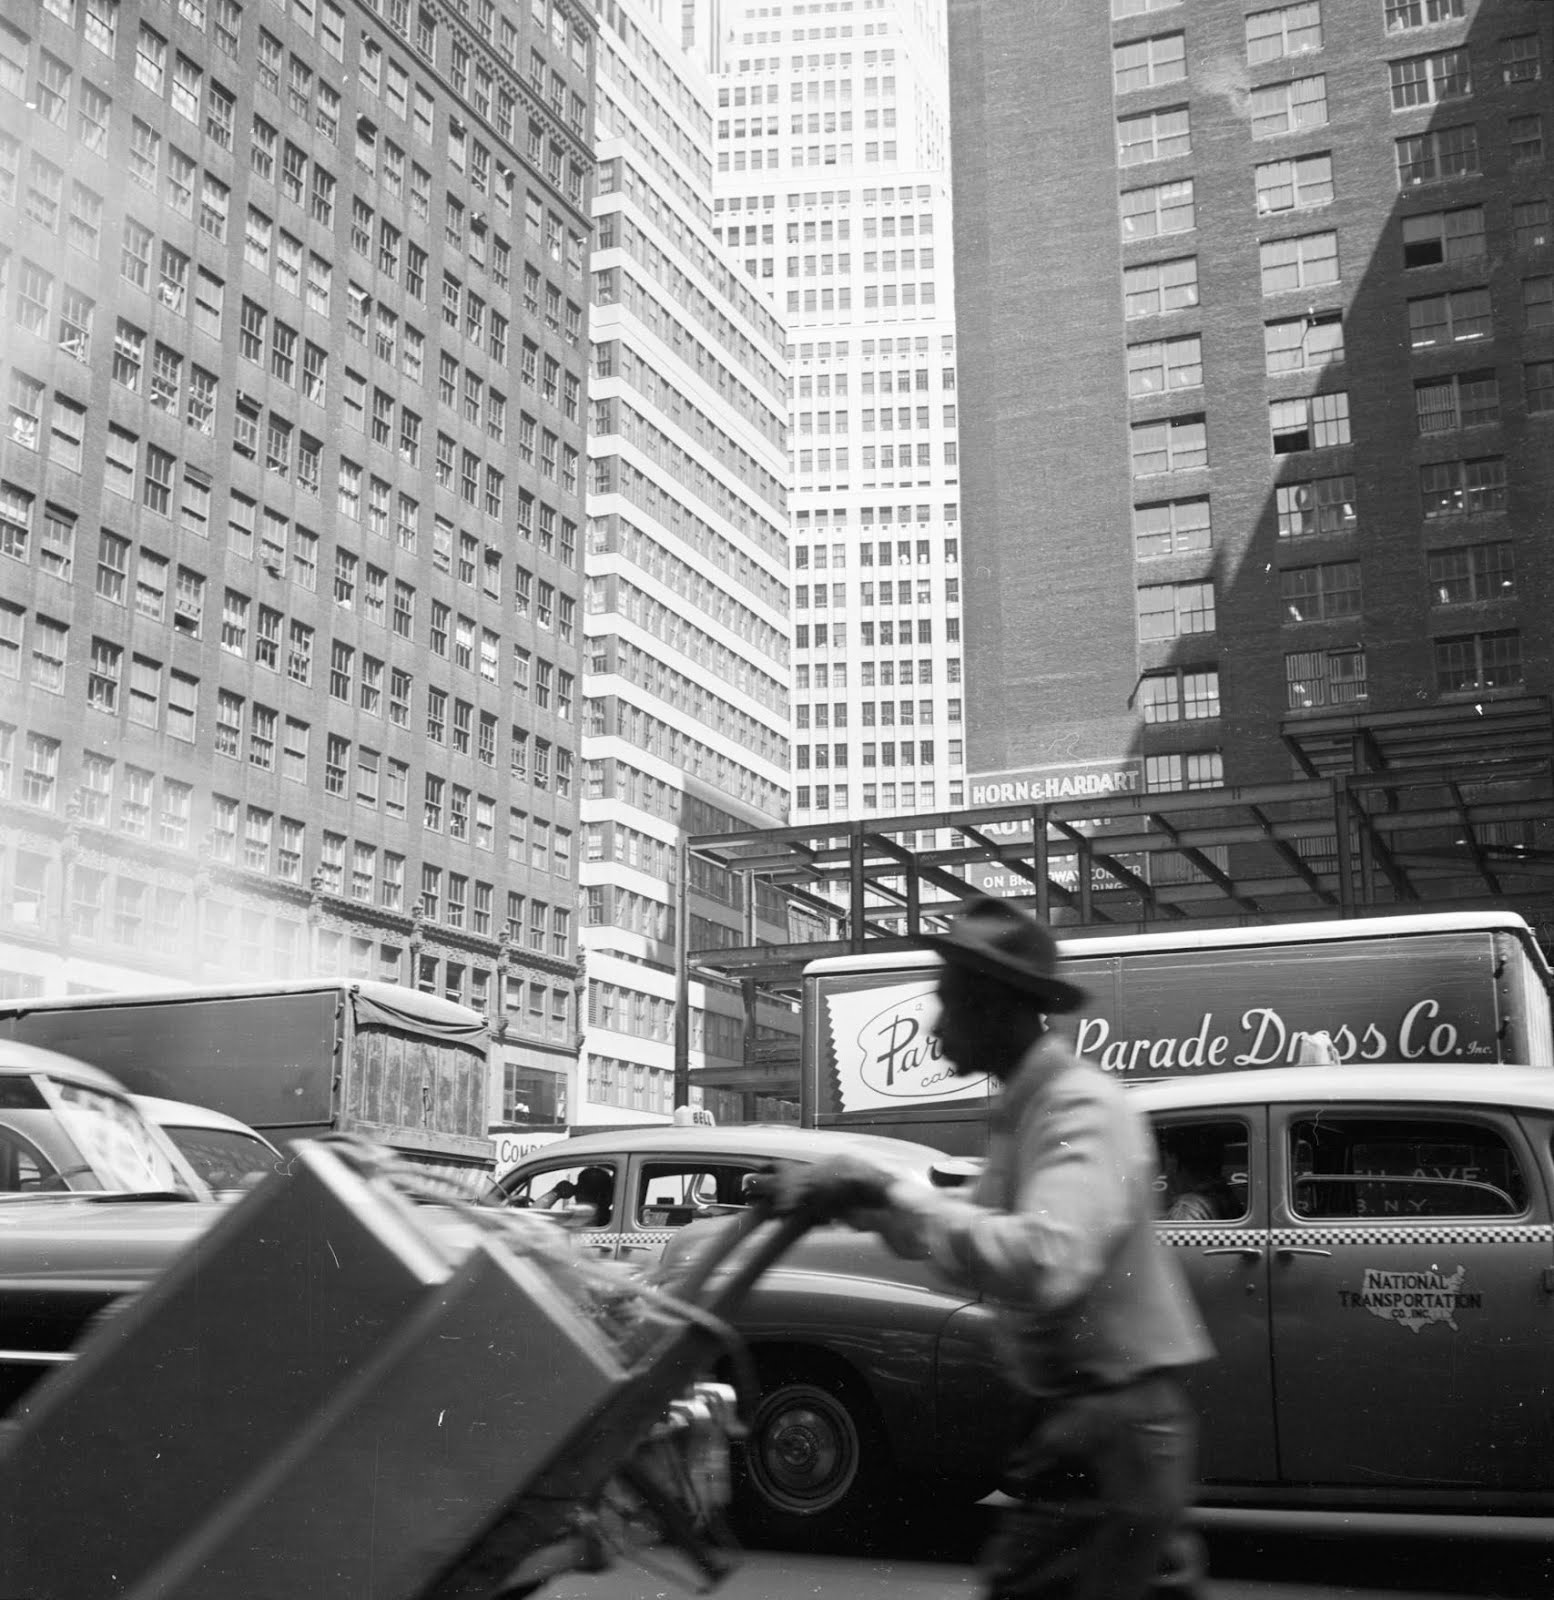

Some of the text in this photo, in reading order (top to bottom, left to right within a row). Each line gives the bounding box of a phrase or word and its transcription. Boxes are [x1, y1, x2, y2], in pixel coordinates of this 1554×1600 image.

[983, 876, 1004, 888] ON
[1075, 1013, 1229, 1071] Parade
[1233, 1008, 1387, 1066] Drss
[1399, 999, 1463, 1058] Co.
[692, 1111, 712, 1126] BELL
[1369, 1273, 1449, 1290] NATIONAL
[1338, 1290, 1482, 1309] TRANSPORTATION
